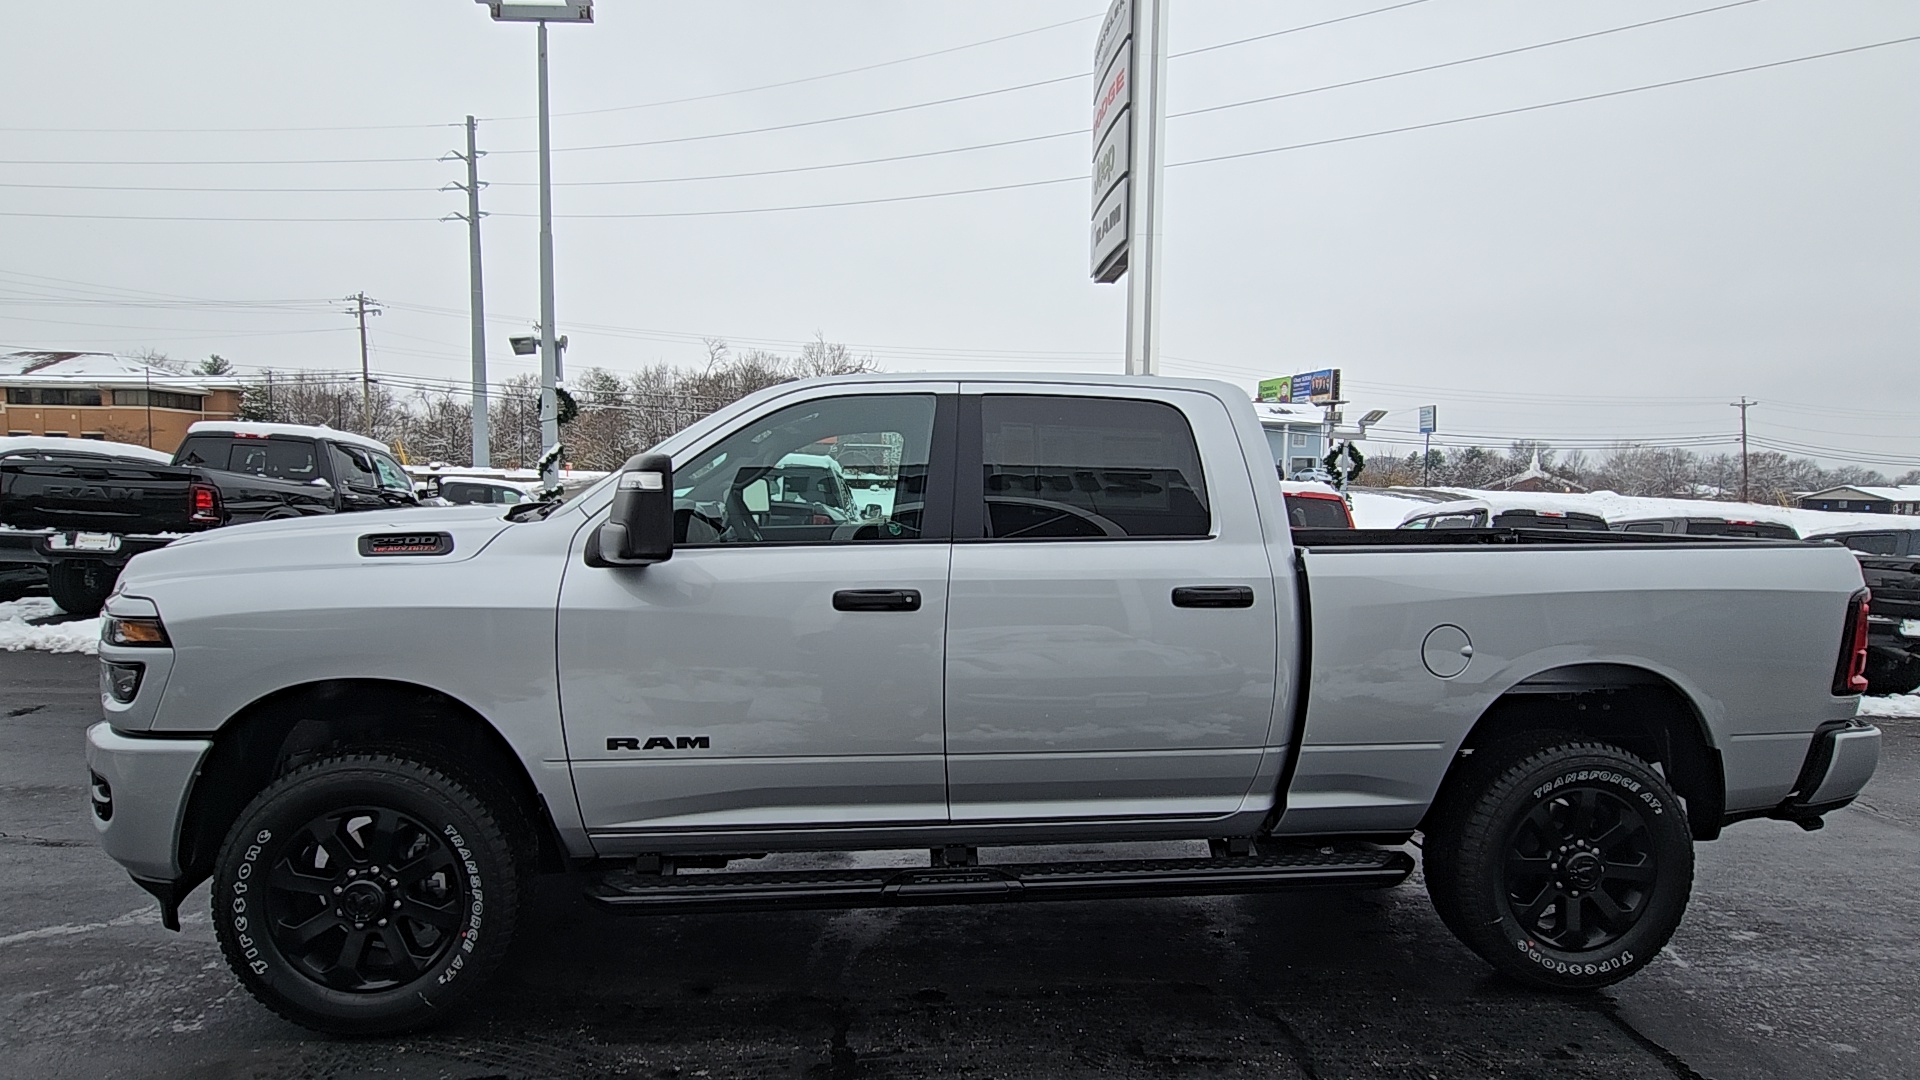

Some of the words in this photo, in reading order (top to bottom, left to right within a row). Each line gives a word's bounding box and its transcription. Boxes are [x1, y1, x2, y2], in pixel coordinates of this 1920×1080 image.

[43, 485, 144, 500] RAM
[373, 536, 436, 545] 2500
[606, 736, 710, 750] RAM
[1533, 770, 1642, 799] TRANSFORCE
[444, 824, 485, 953] TRANSFORCE
